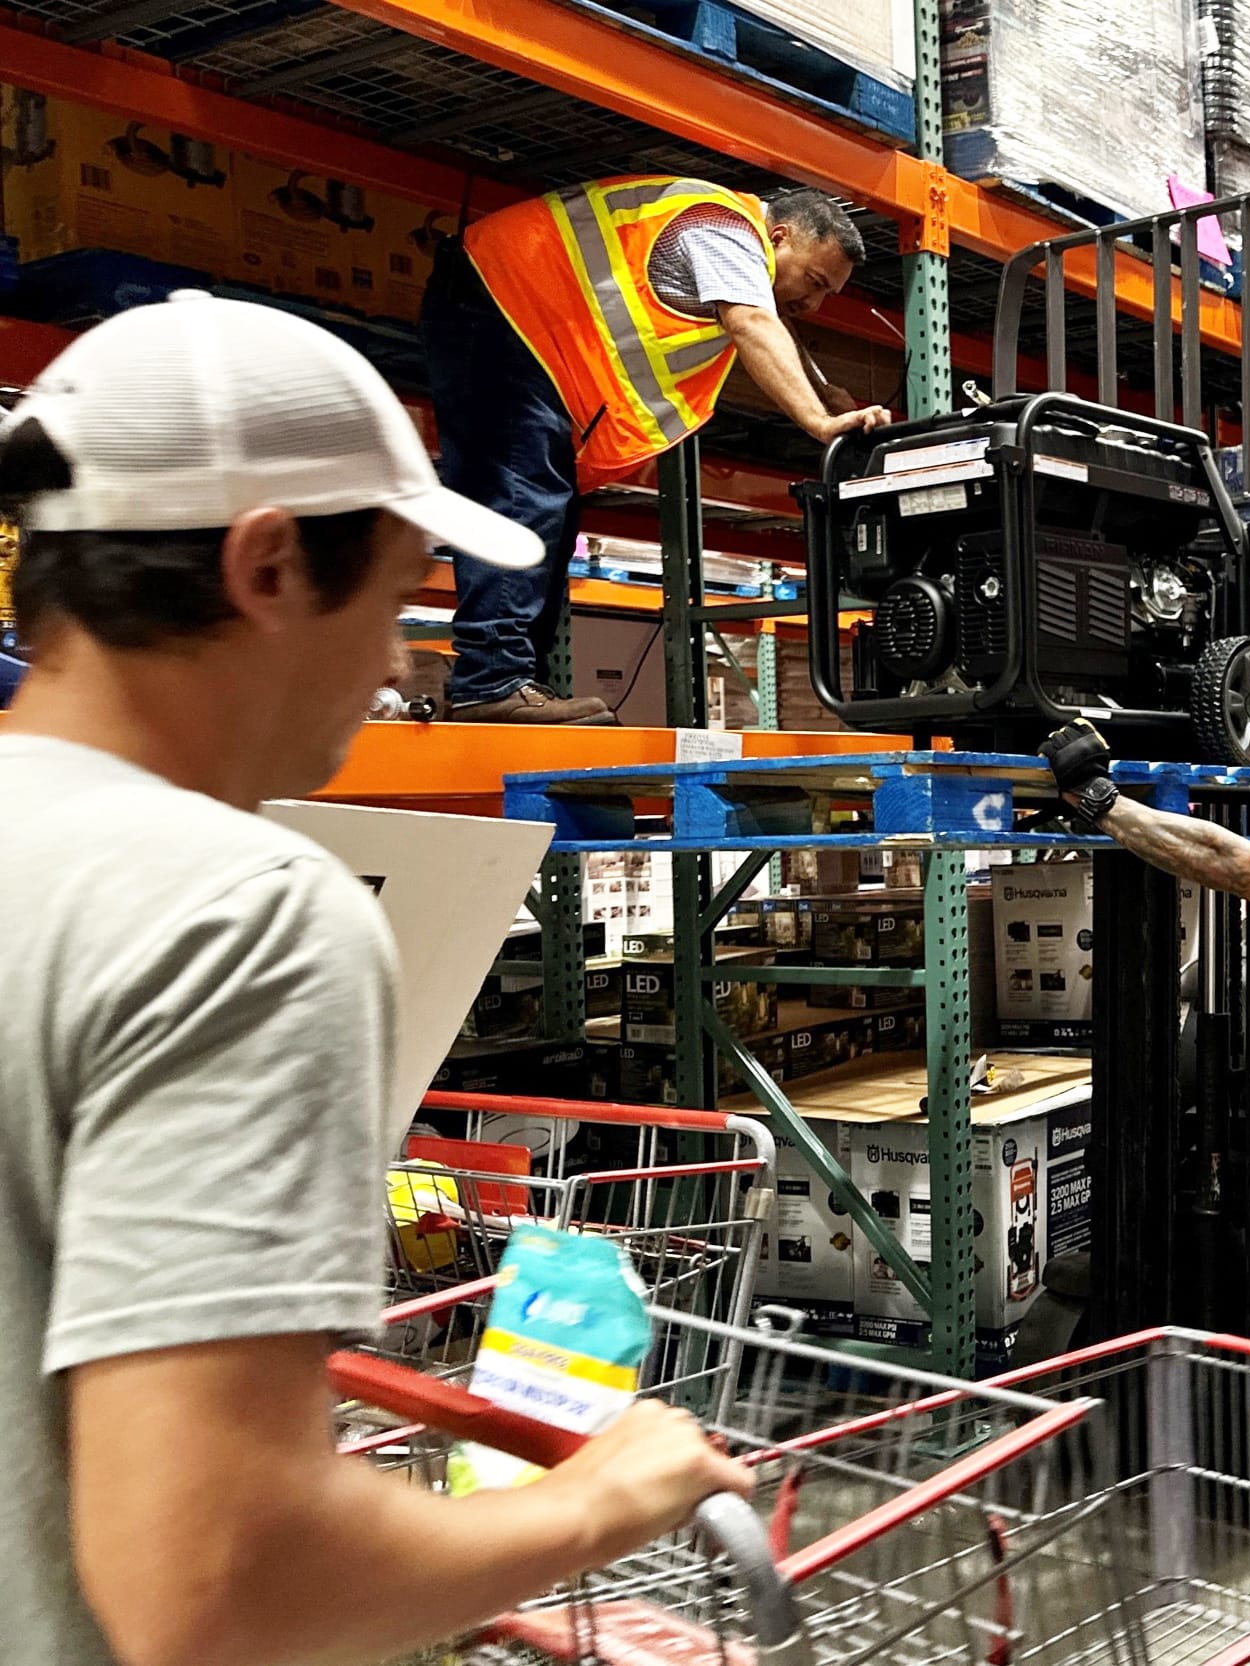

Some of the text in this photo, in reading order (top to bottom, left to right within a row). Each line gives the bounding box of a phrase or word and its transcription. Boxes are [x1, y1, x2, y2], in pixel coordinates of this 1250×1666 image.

[878, 917, 896, 932] LED
[623, 940, 645, 954] LED
[586, 974, 609, 989] LED
[626, 974, 661, 994] LED
[878, 1016, 896, 1031] LED
[791, 1032, 812, 1049] LED
[1061, 1122, 1092, 1141] Husqva
[881, 1147, 929, 1166] Husqva
[1070, 1177, 1087, 1194] MAX
[1063, 1193, 1081, 1212] MAX
